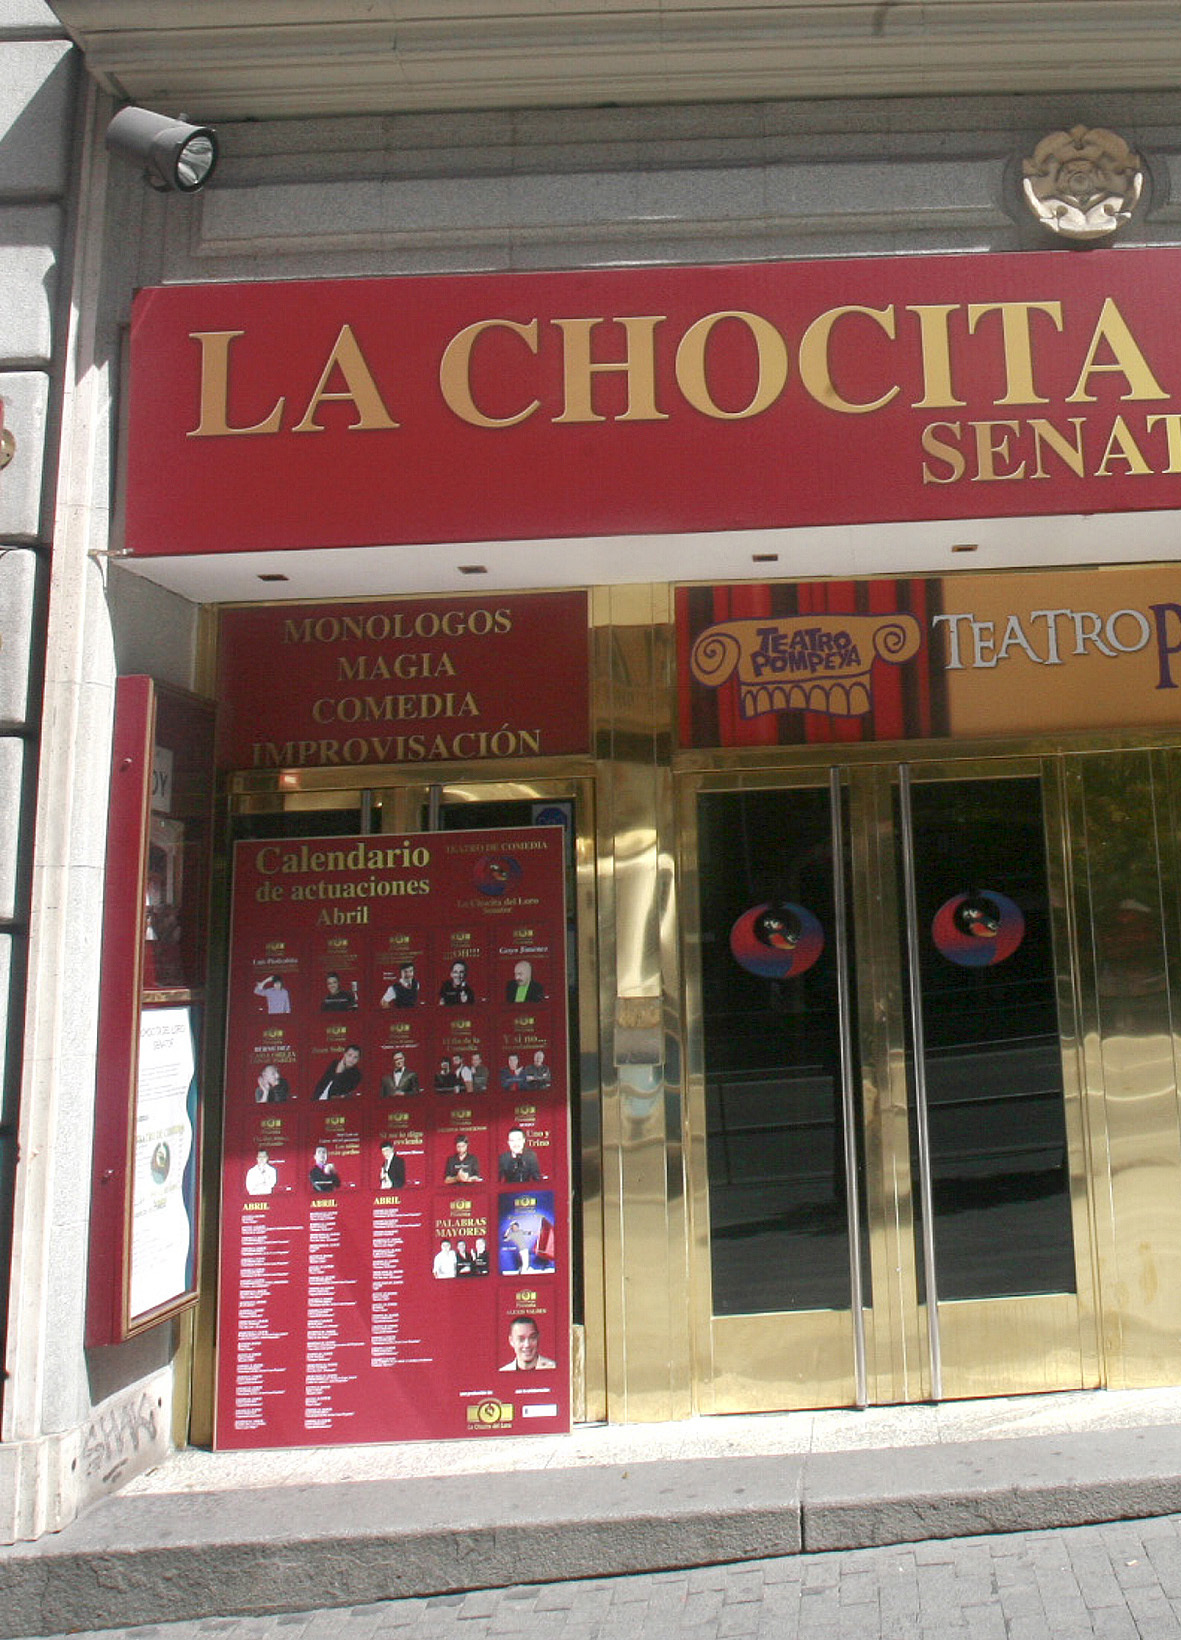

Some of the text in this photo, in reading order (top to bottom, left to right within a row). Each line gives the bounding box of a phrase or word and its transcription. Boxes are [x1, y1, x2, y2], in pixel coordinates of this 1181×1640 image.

[186, 324, 401, 439] LA
[438, 297, 1171, 429] CHOCITA
[284, 608, 513, 645] MONOLOGOS
[756, 626, 853, 652] TEATRO
[931, 607, 1151, 670] TEATRO
[338, 652, 459, 682] MAGIA
[751, 645, 862, 678] POMPEYA
[312, 692, 481, 725] COMEDIA
[253, 722, 542, 767] IMPROVISACIÓN
[256, 840, 431, 876] Calendario
[501, 841, 548, 851] COMEDIA
[256, 875, 431, 903] de actuaciones
[317, 905, 370, 926] Abril
[242, 1203, 269, 1211] ABRIL
[310, 1199, 337, 1208] ABRIL
[374, 1197, 401, 1205] ABRIL
[435, 1217, 487, 1228] PALABRAS
[435, 1227, 487, 1238] MAYORES
